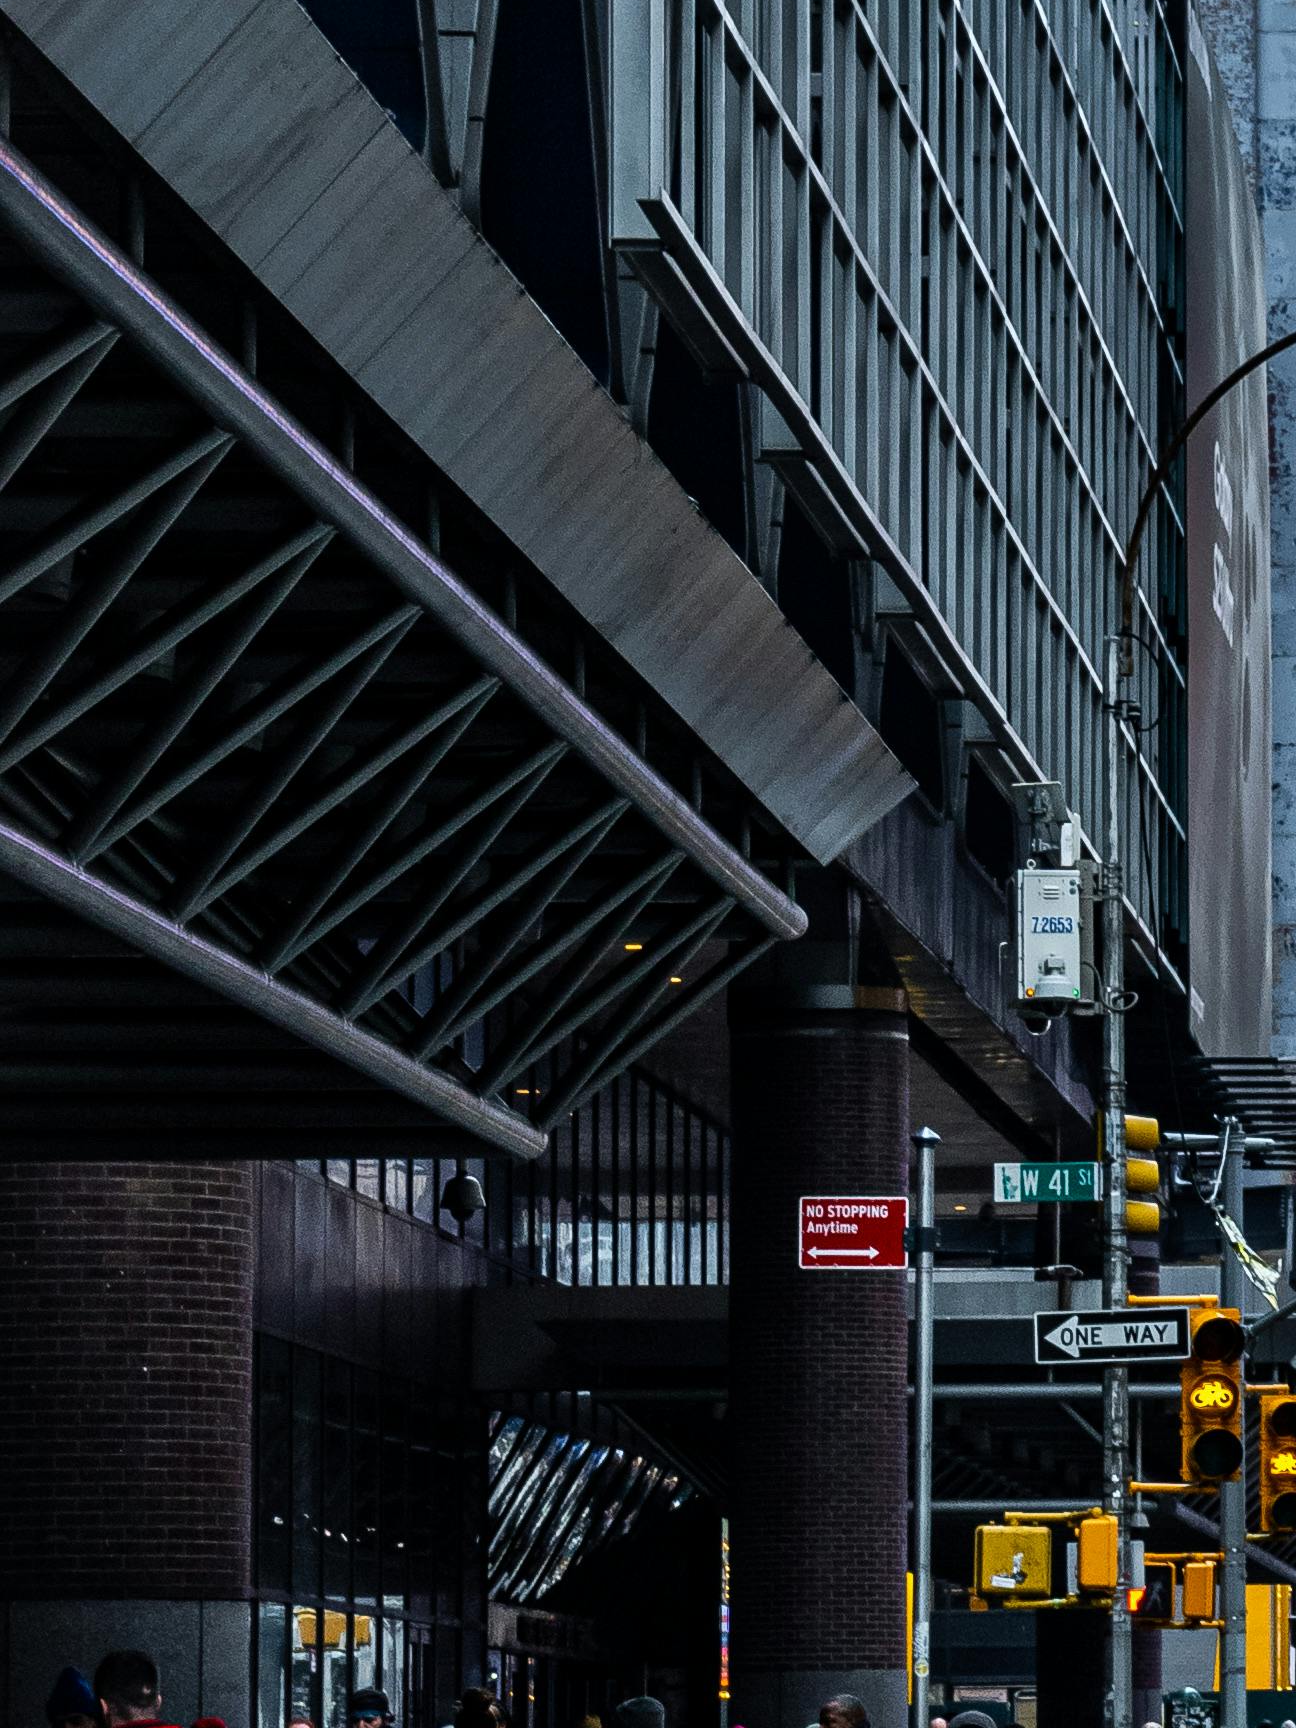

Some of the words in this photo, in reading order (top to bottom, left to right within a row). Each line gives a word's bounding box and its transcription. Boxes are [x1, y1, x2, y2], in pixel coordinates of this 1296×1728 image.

[1031, 916, 1073, 934] 72653
[1022, 1170, 1040, 1197] W
[1048, 1169, 1070, 1196] 41
[1078, 1168, 1092, 1186] St
[806, 1204, 823, 1218] NO
[827, 1204, 889, 1219] STOPPING
[806, 1221, 858, 1237] Anytime
[1060, 1326, 1103, 1347] ONE
[1123, 1324, 1169, 1344] WAY
